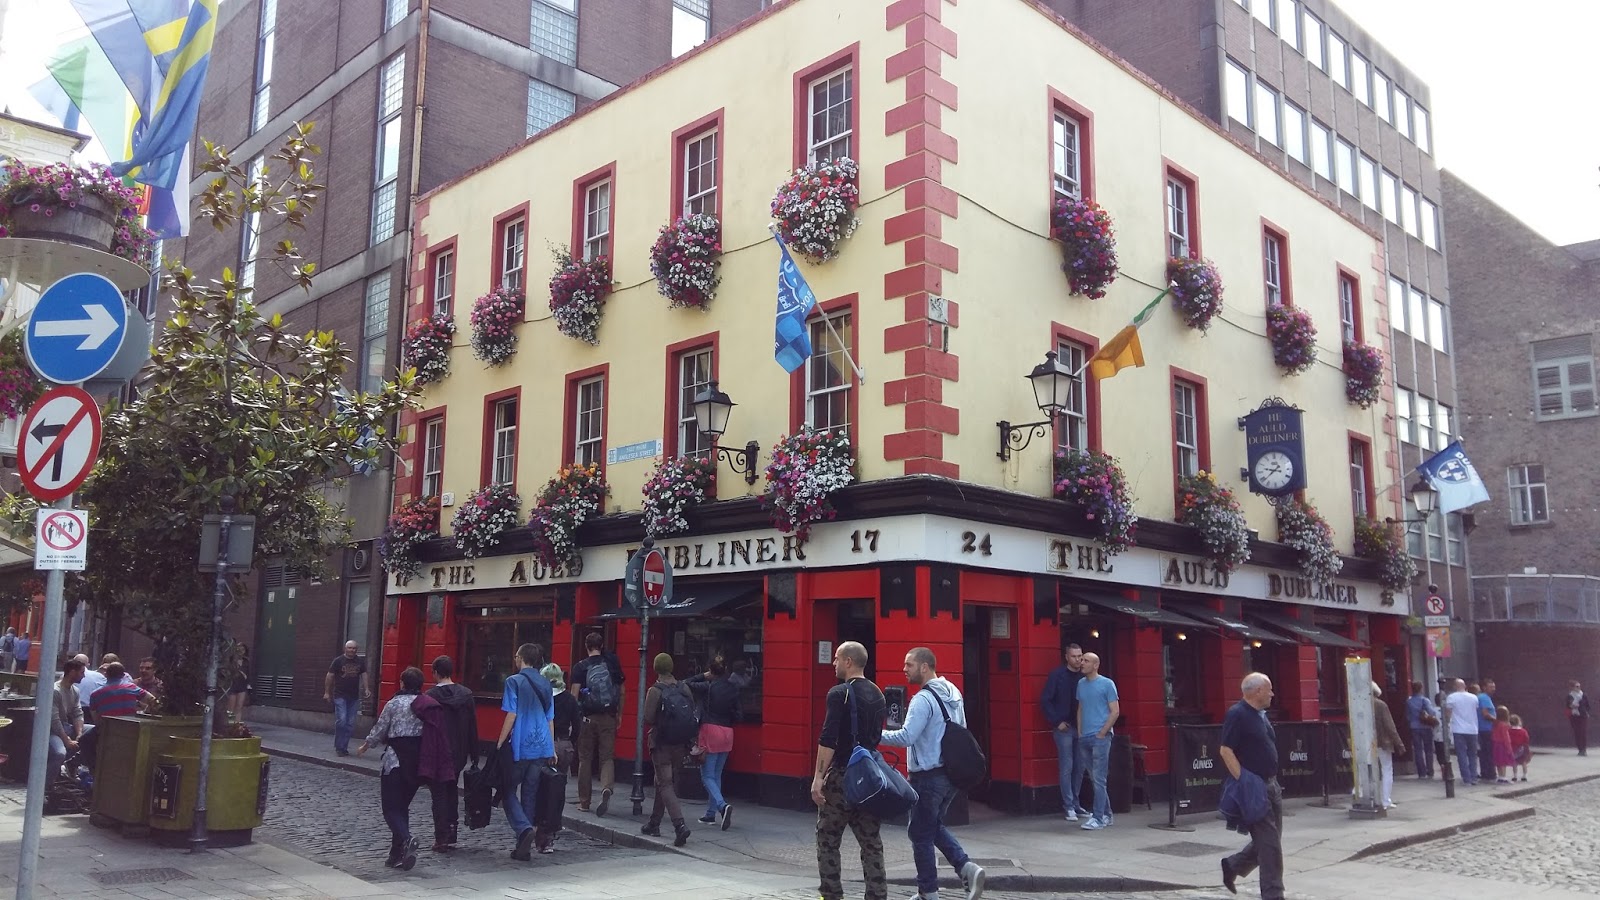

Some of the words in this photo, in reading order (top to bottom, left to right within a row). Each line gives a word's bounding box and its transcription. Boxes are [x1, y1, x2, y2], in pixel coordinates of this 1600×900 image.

[1259, 423, 1287, 433] AULD
[1248, 432, 1299, 445] DUBLINER
[639, 448, 654, 457] STREET
[850, 529, 880, 553] 17
[961, 531, 993, 556] 24
[430, 565, 475, 588] THE
[1050, 539, 1113, 573] THE
[1267, 573, 1358, 605] DUBLINER
[1192, 758, 1213, 770] GUINNESS
